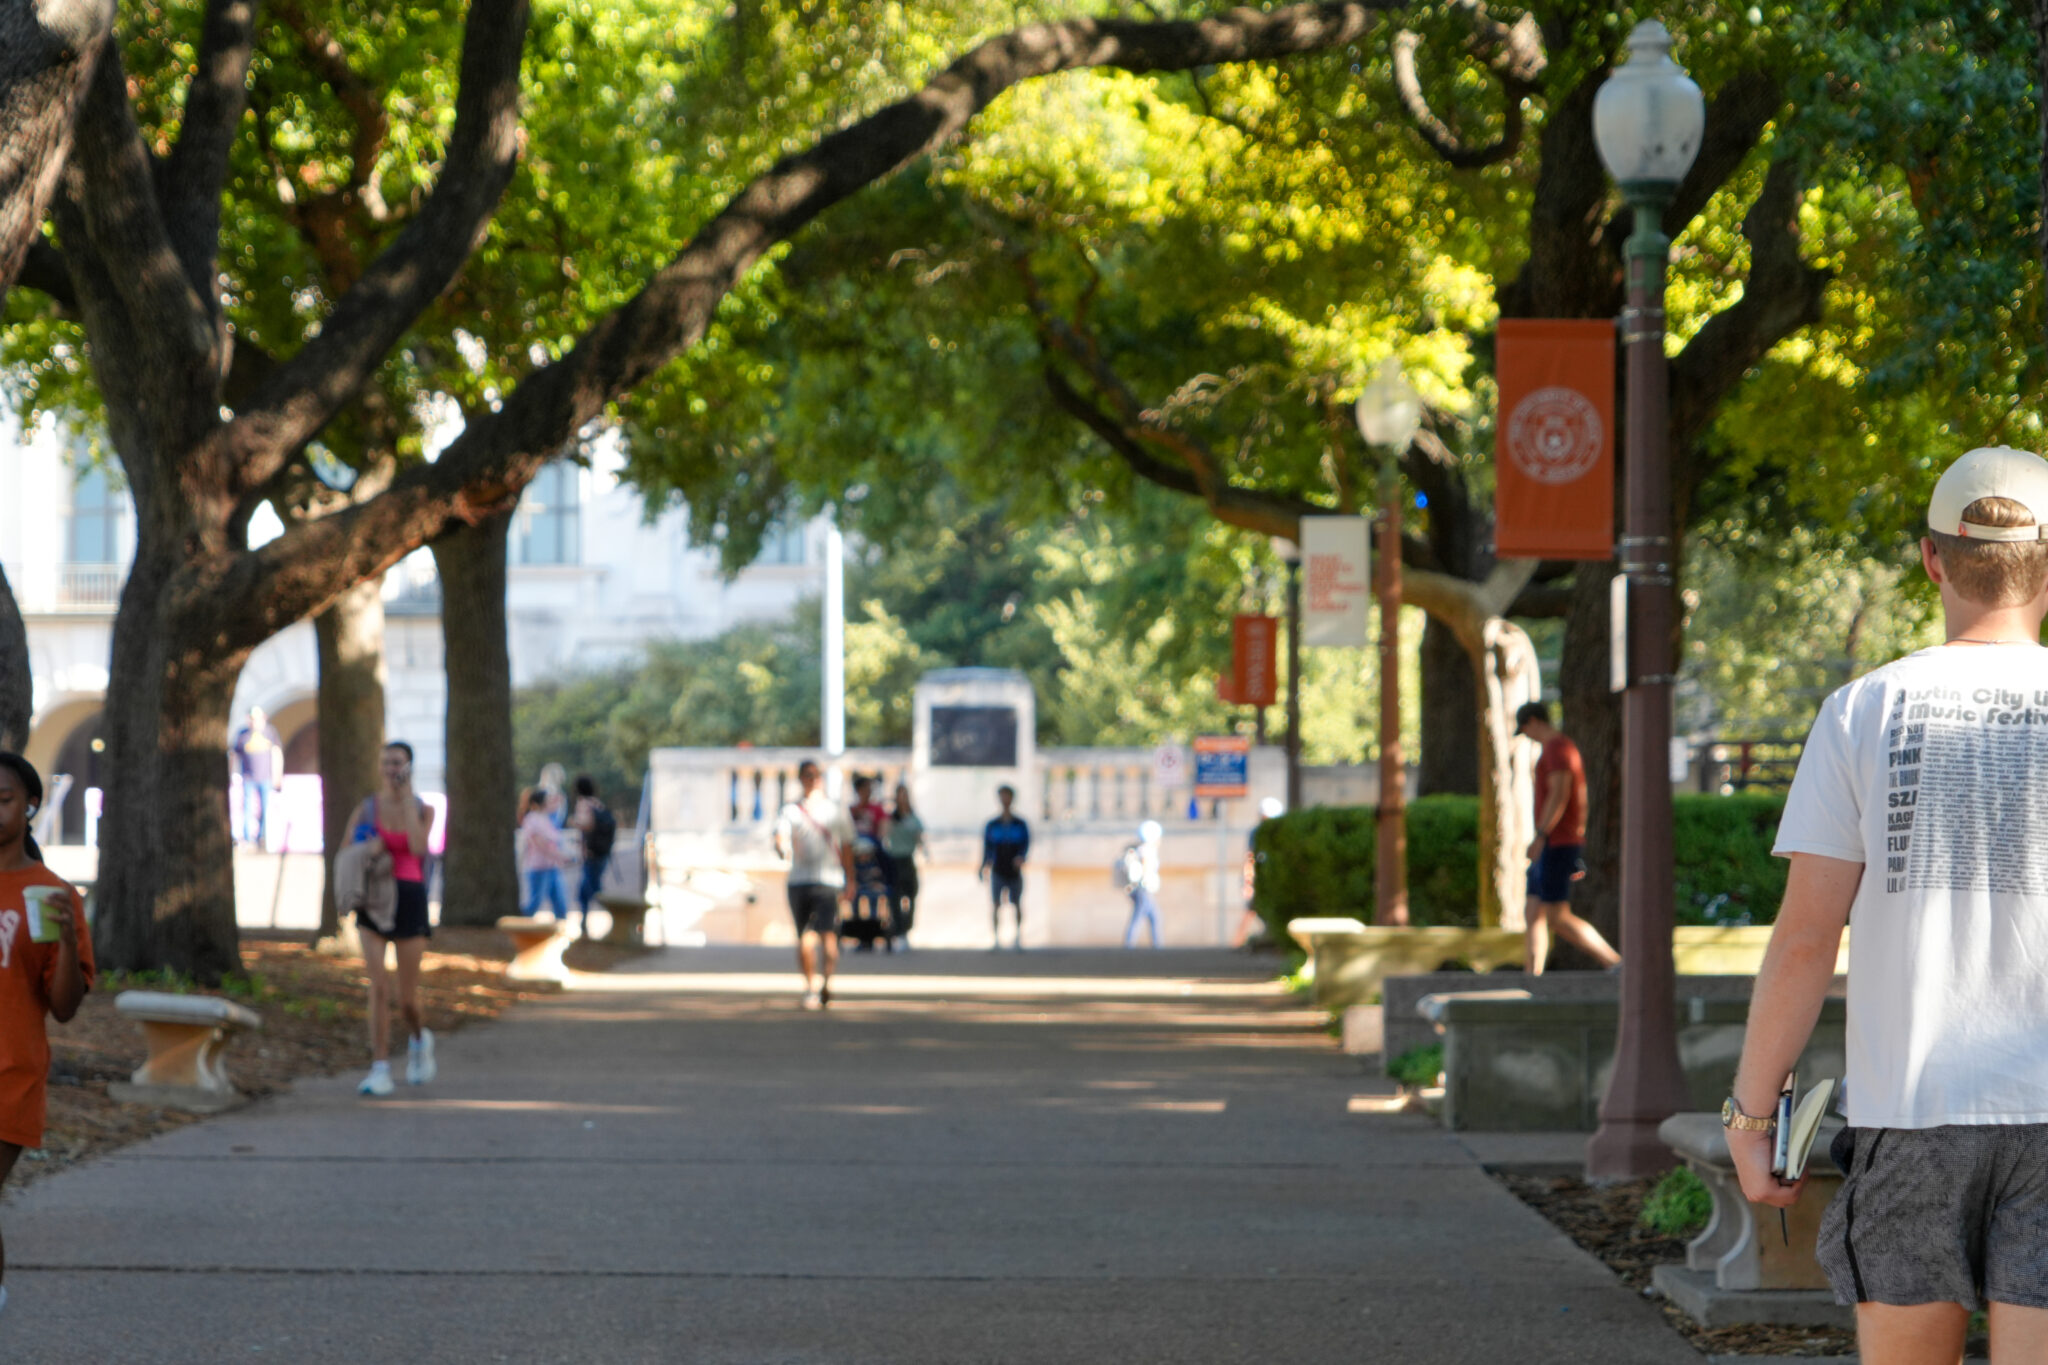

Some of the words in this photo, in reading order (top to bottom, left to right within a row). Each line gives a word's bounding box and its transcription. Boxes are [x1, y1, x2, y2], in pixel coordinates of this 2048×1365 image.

[1893, 686, 1961, 706] Austin
[1972, 688, 2023, 710] City
[1908, 704, 1976, 721] Music
